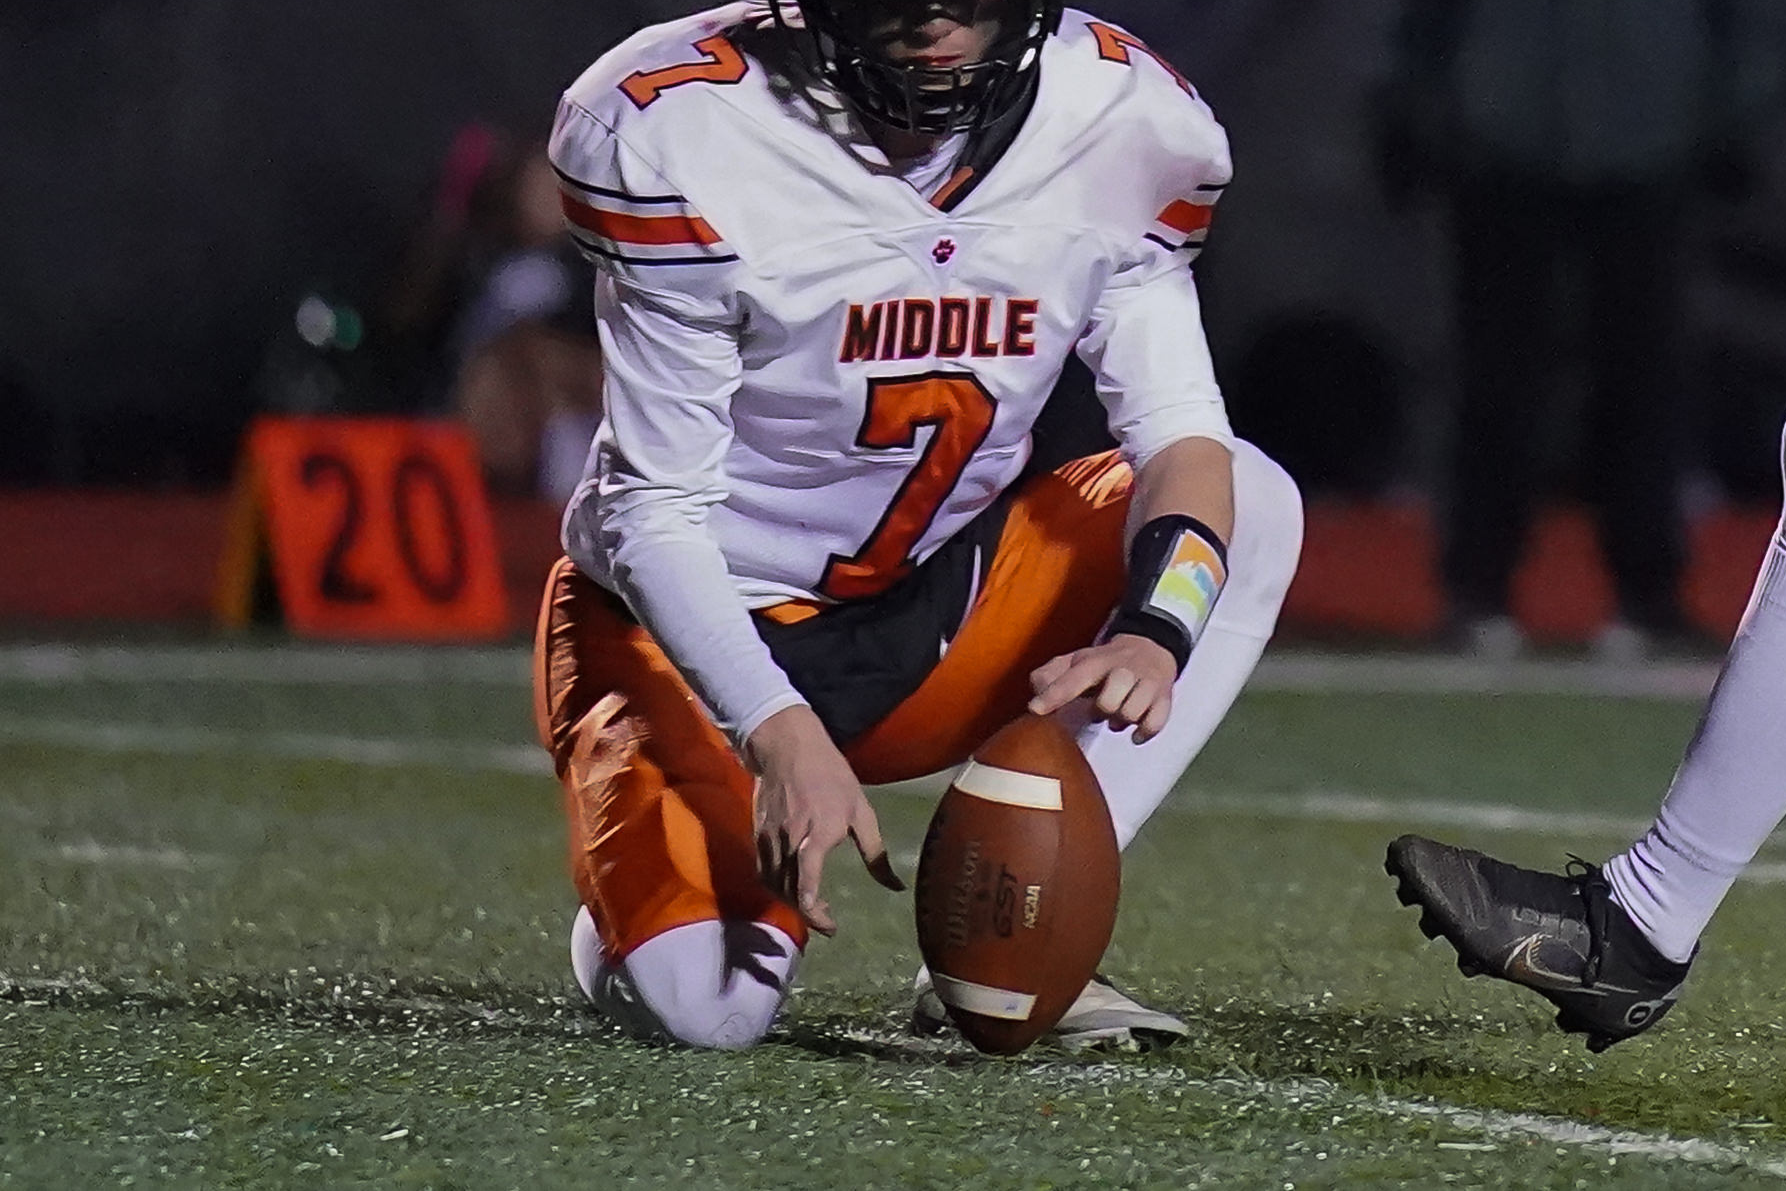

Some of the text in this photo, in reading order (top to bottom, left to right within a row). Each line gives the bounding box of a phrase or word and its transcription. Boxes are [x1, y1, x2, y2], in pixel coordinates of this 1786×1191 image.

[617, 32, 749, 111] 7
[838, 296, 1040, 364] MIDDLE
[301, 453, 469, 604] 20
[816, 369, 999, 601] 7
